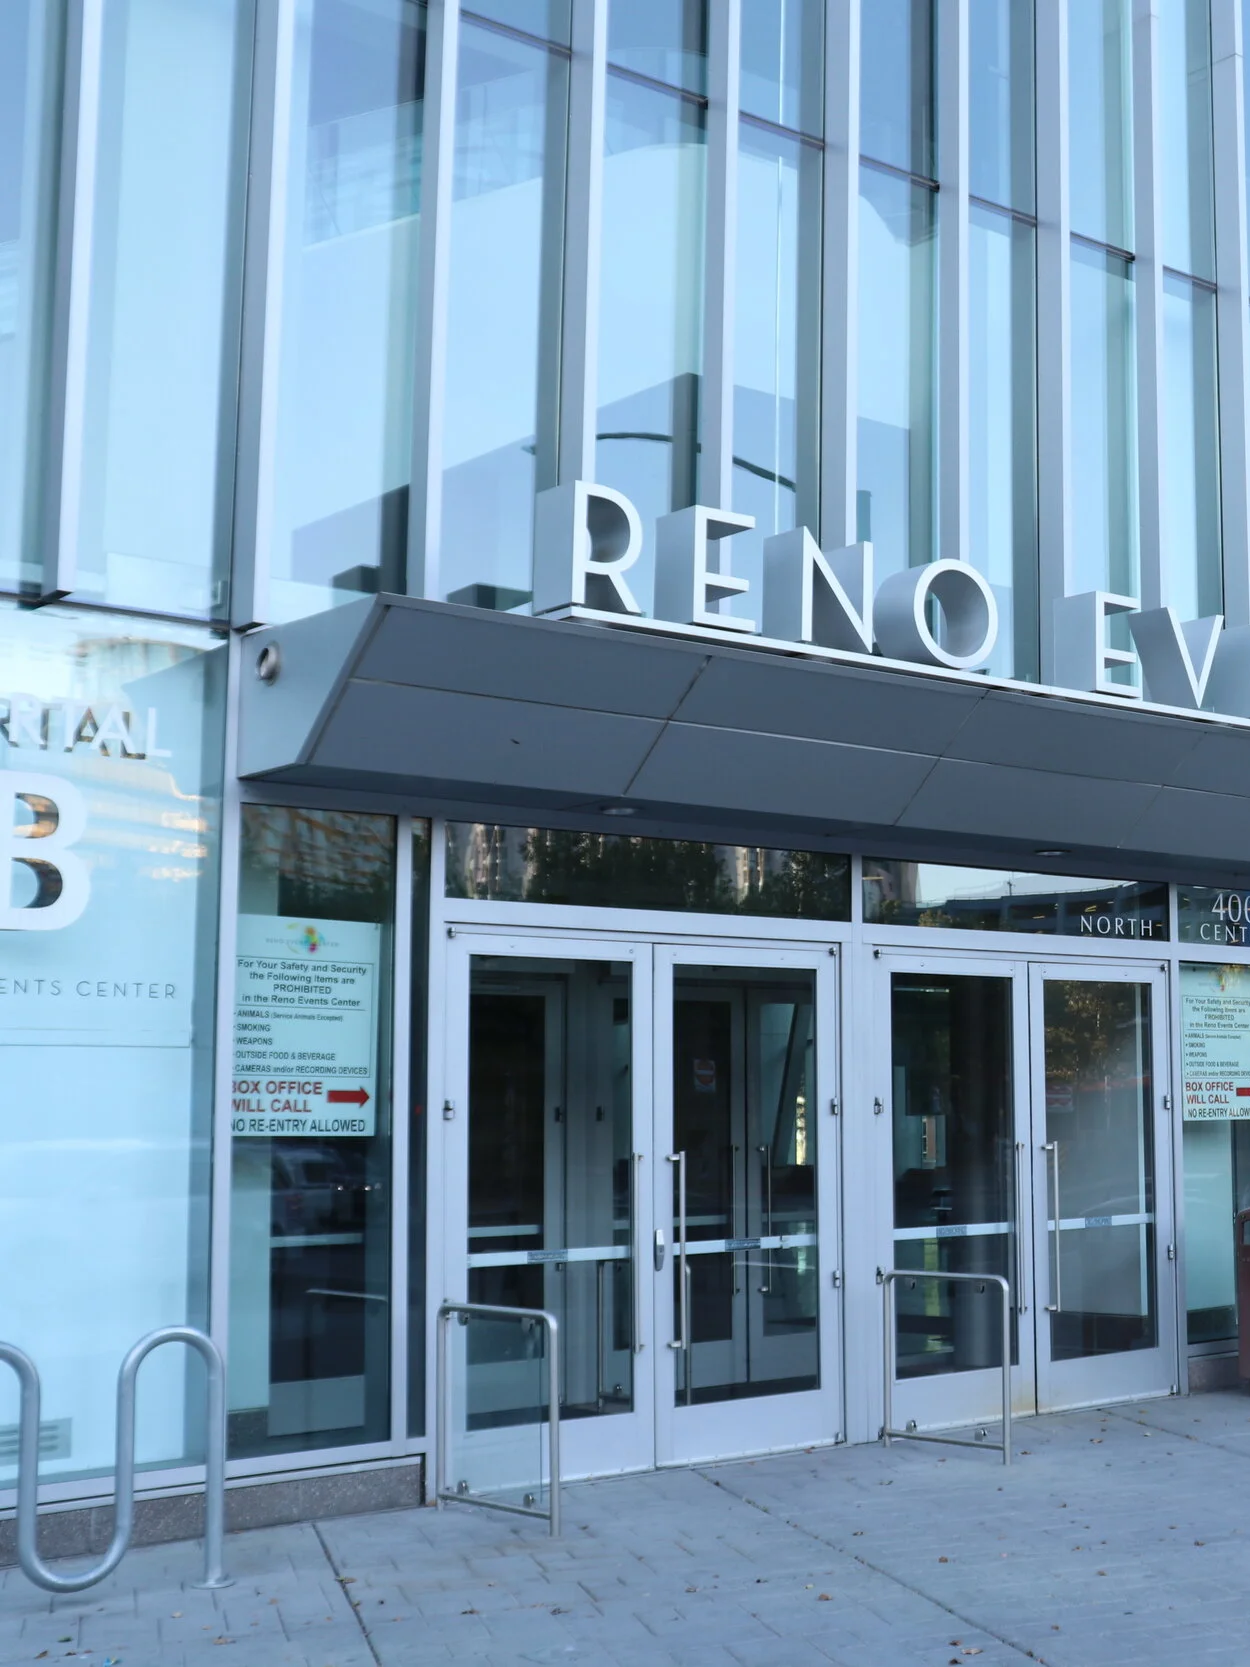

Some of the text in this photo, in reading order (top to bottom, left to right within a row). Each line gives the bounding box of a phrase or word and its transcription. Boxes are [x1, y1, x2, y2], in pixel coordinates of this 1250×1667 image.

[572, 480, 998, 669] RENO
[1080, 915, 1153, 937] NORTH
[237, 960, 367, 976] For Your Safety and Security
[250, 971, 355, 985] the Following Items are
[76, 980, 177, 999] CENTER
[273, 984, 332, 995] PROHIBITED
[242, 994, 361, 1007] in the Reno Events Center
[237, 1010, 270, 1019] ANIMALS
[237, 1024, 271, 1032] SMOKING
[236, 1037, 273, 1045] WEAPONS
[235, 1051, 267, 1059] OUTSIDE
[268, 1051, 288, 1060] FOOD
[297, 1052, 336, 1061] BEVERAGE
[235, 1065, 368, 1075] CAMERAS and/or RECORDING DEVICES
[265, 1081, 323, 1095] OFFICE
[1185, 1082, 1234, 1091] BOX OFFICE
[1186, 1094, 1230, 1104] WILL CALL
[270, 1099, 312, 1113] CALL
[1188, 1108, 1197, 1118] NO
[1198, 1108, 1228, 1117] RE-ENTRY
[249, 1119, 307, 1132] RE-ENTRY
[310, 1119, 365, 1132] ALLOWED
